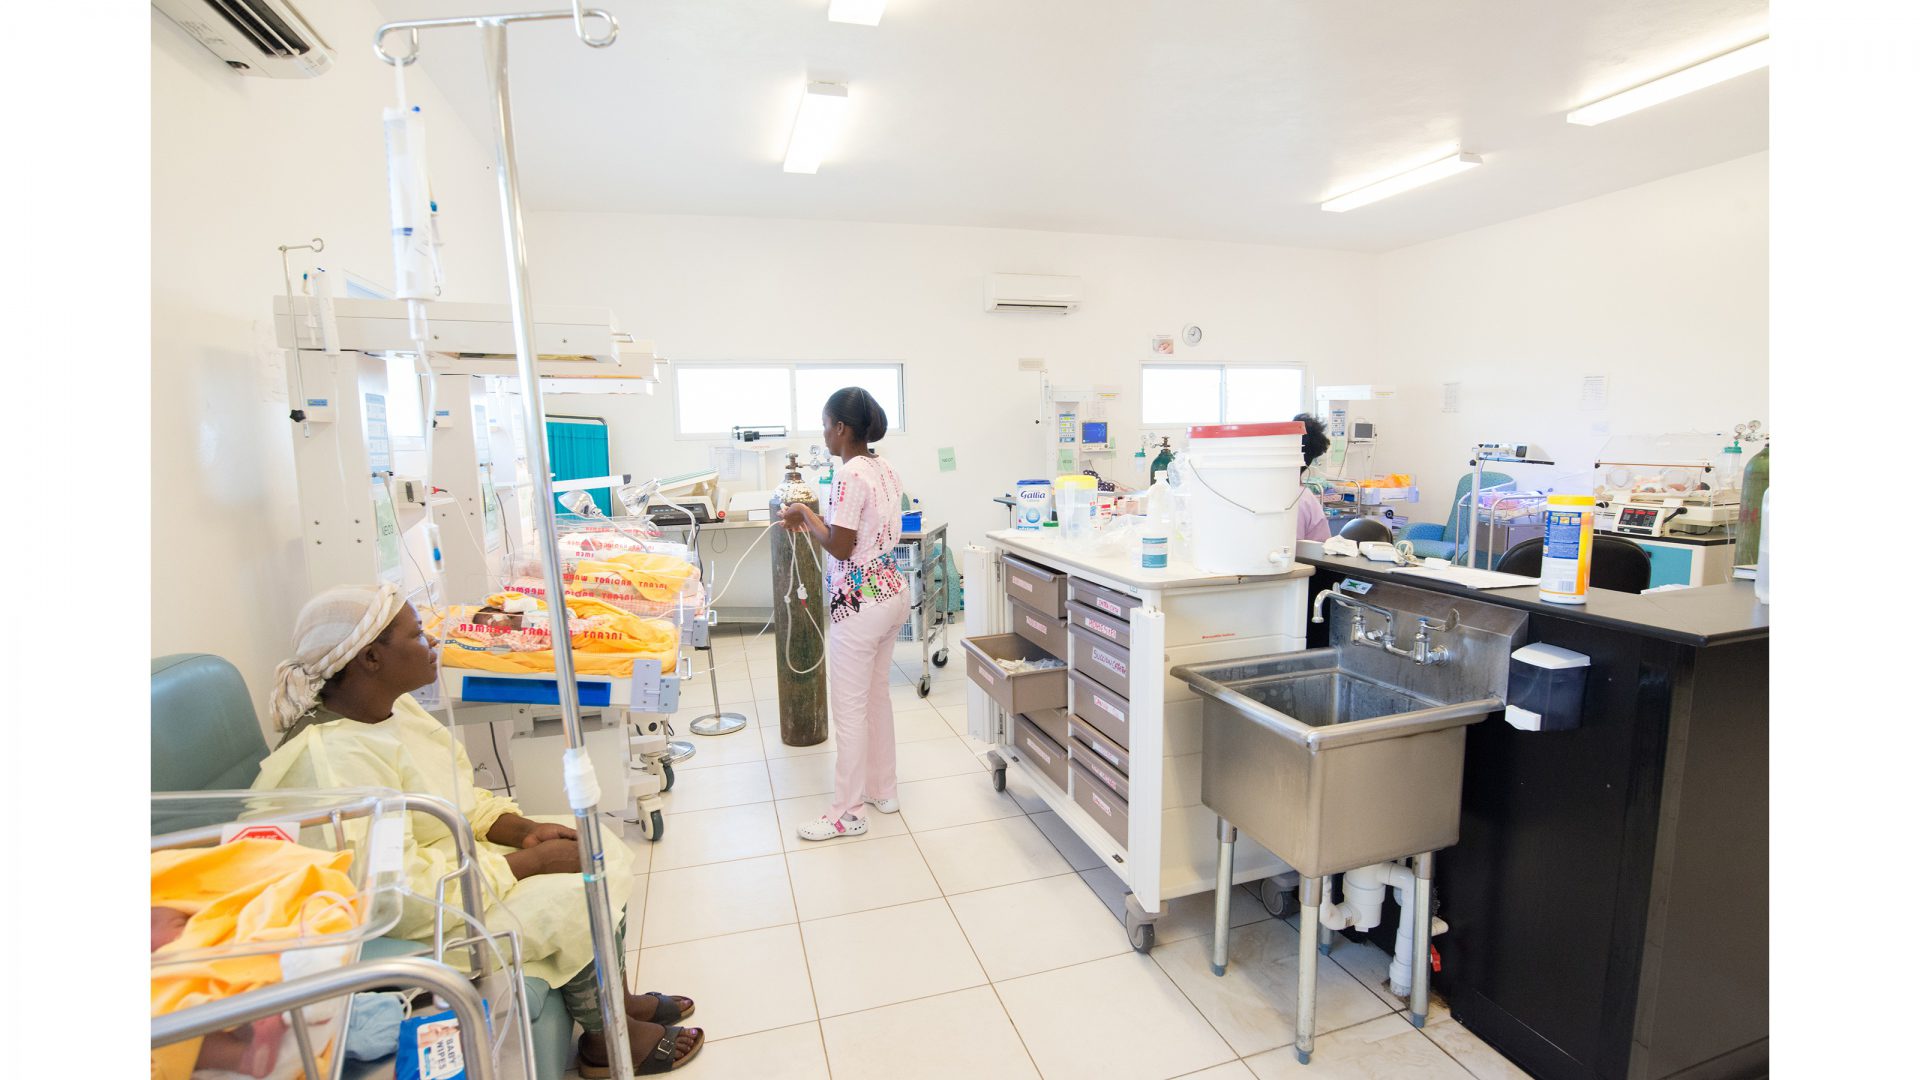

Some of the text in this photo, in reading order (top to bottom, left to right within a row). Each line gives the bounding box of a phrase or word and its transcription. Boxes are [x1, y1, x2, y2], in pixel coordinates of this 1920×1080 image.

[1020, 490, 1046, 499] Gallia
[436, 1039, 447, 1070] WIPES
[446, 1038, 457, 1064] BABY
